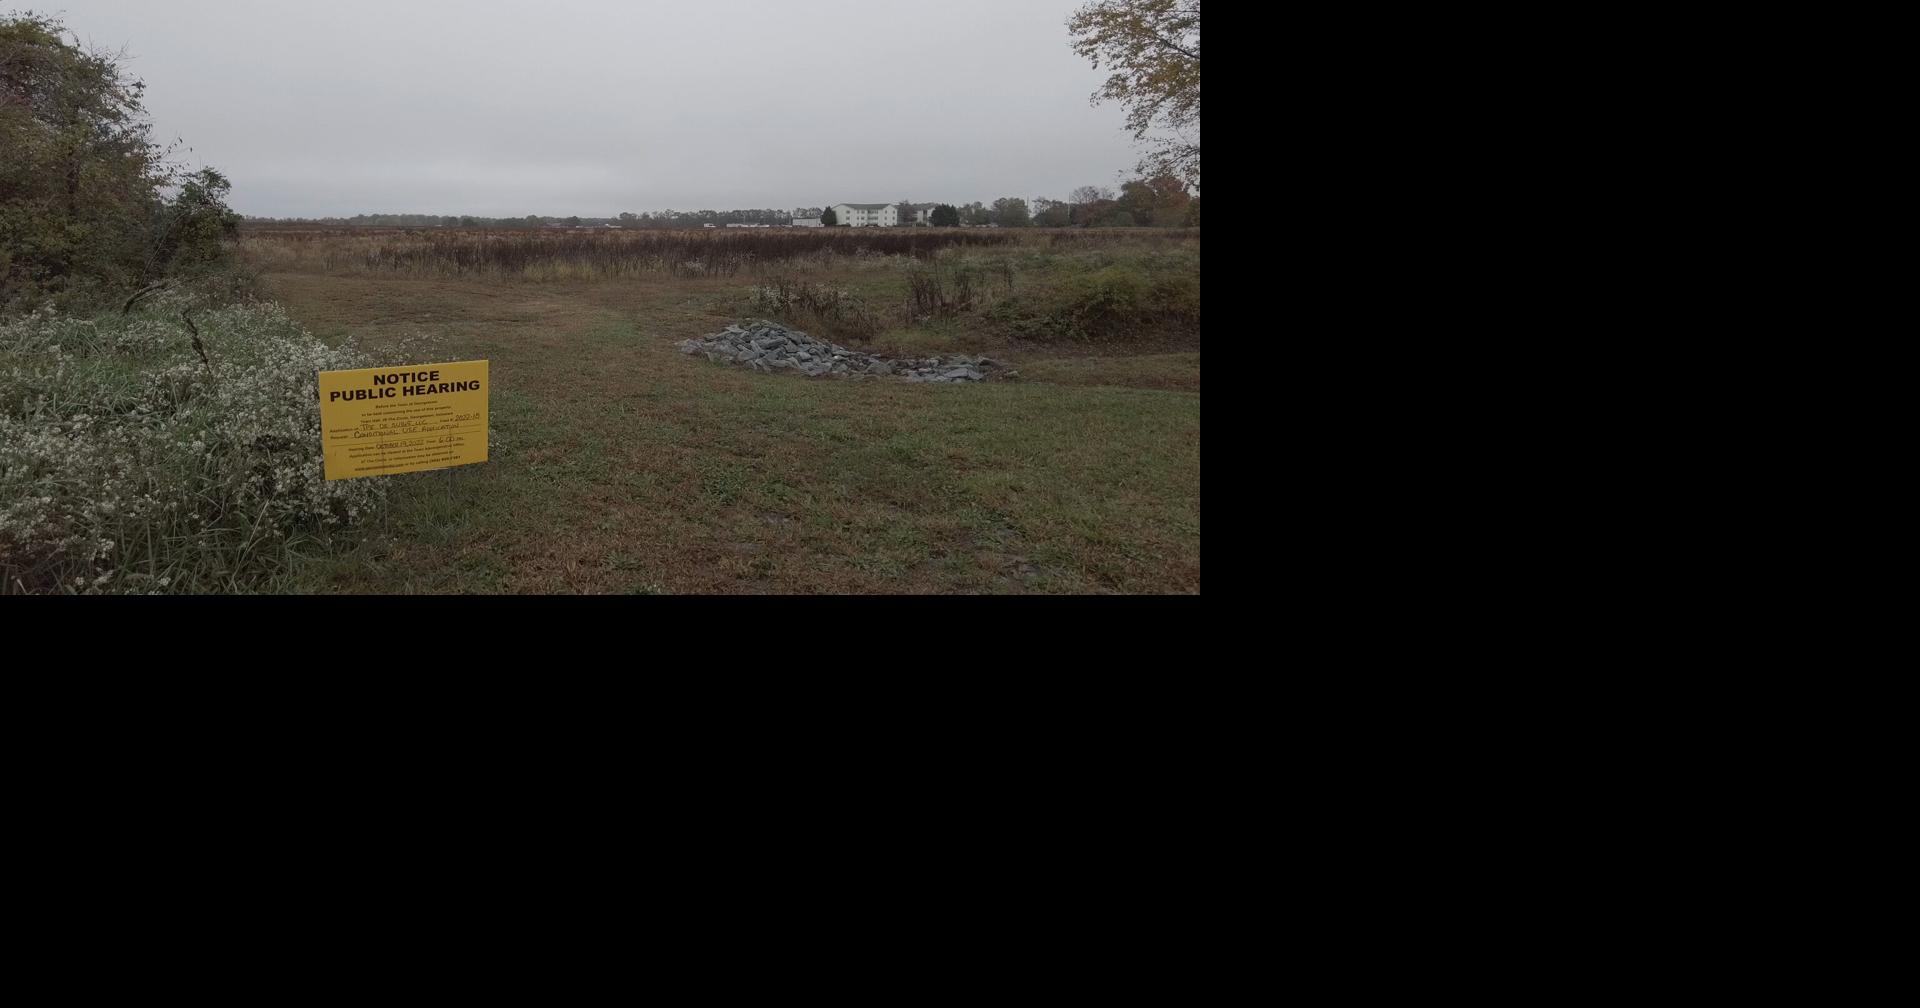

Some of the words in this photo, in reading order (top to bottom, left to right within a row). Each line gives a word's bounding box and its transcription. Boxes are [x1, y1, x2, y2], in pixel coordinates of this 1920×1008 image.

[374, 371, 440, 385] NOTICE
[330, 387, 396, 403] PUBLIC
[403, 380, 480, 396] HEARING
